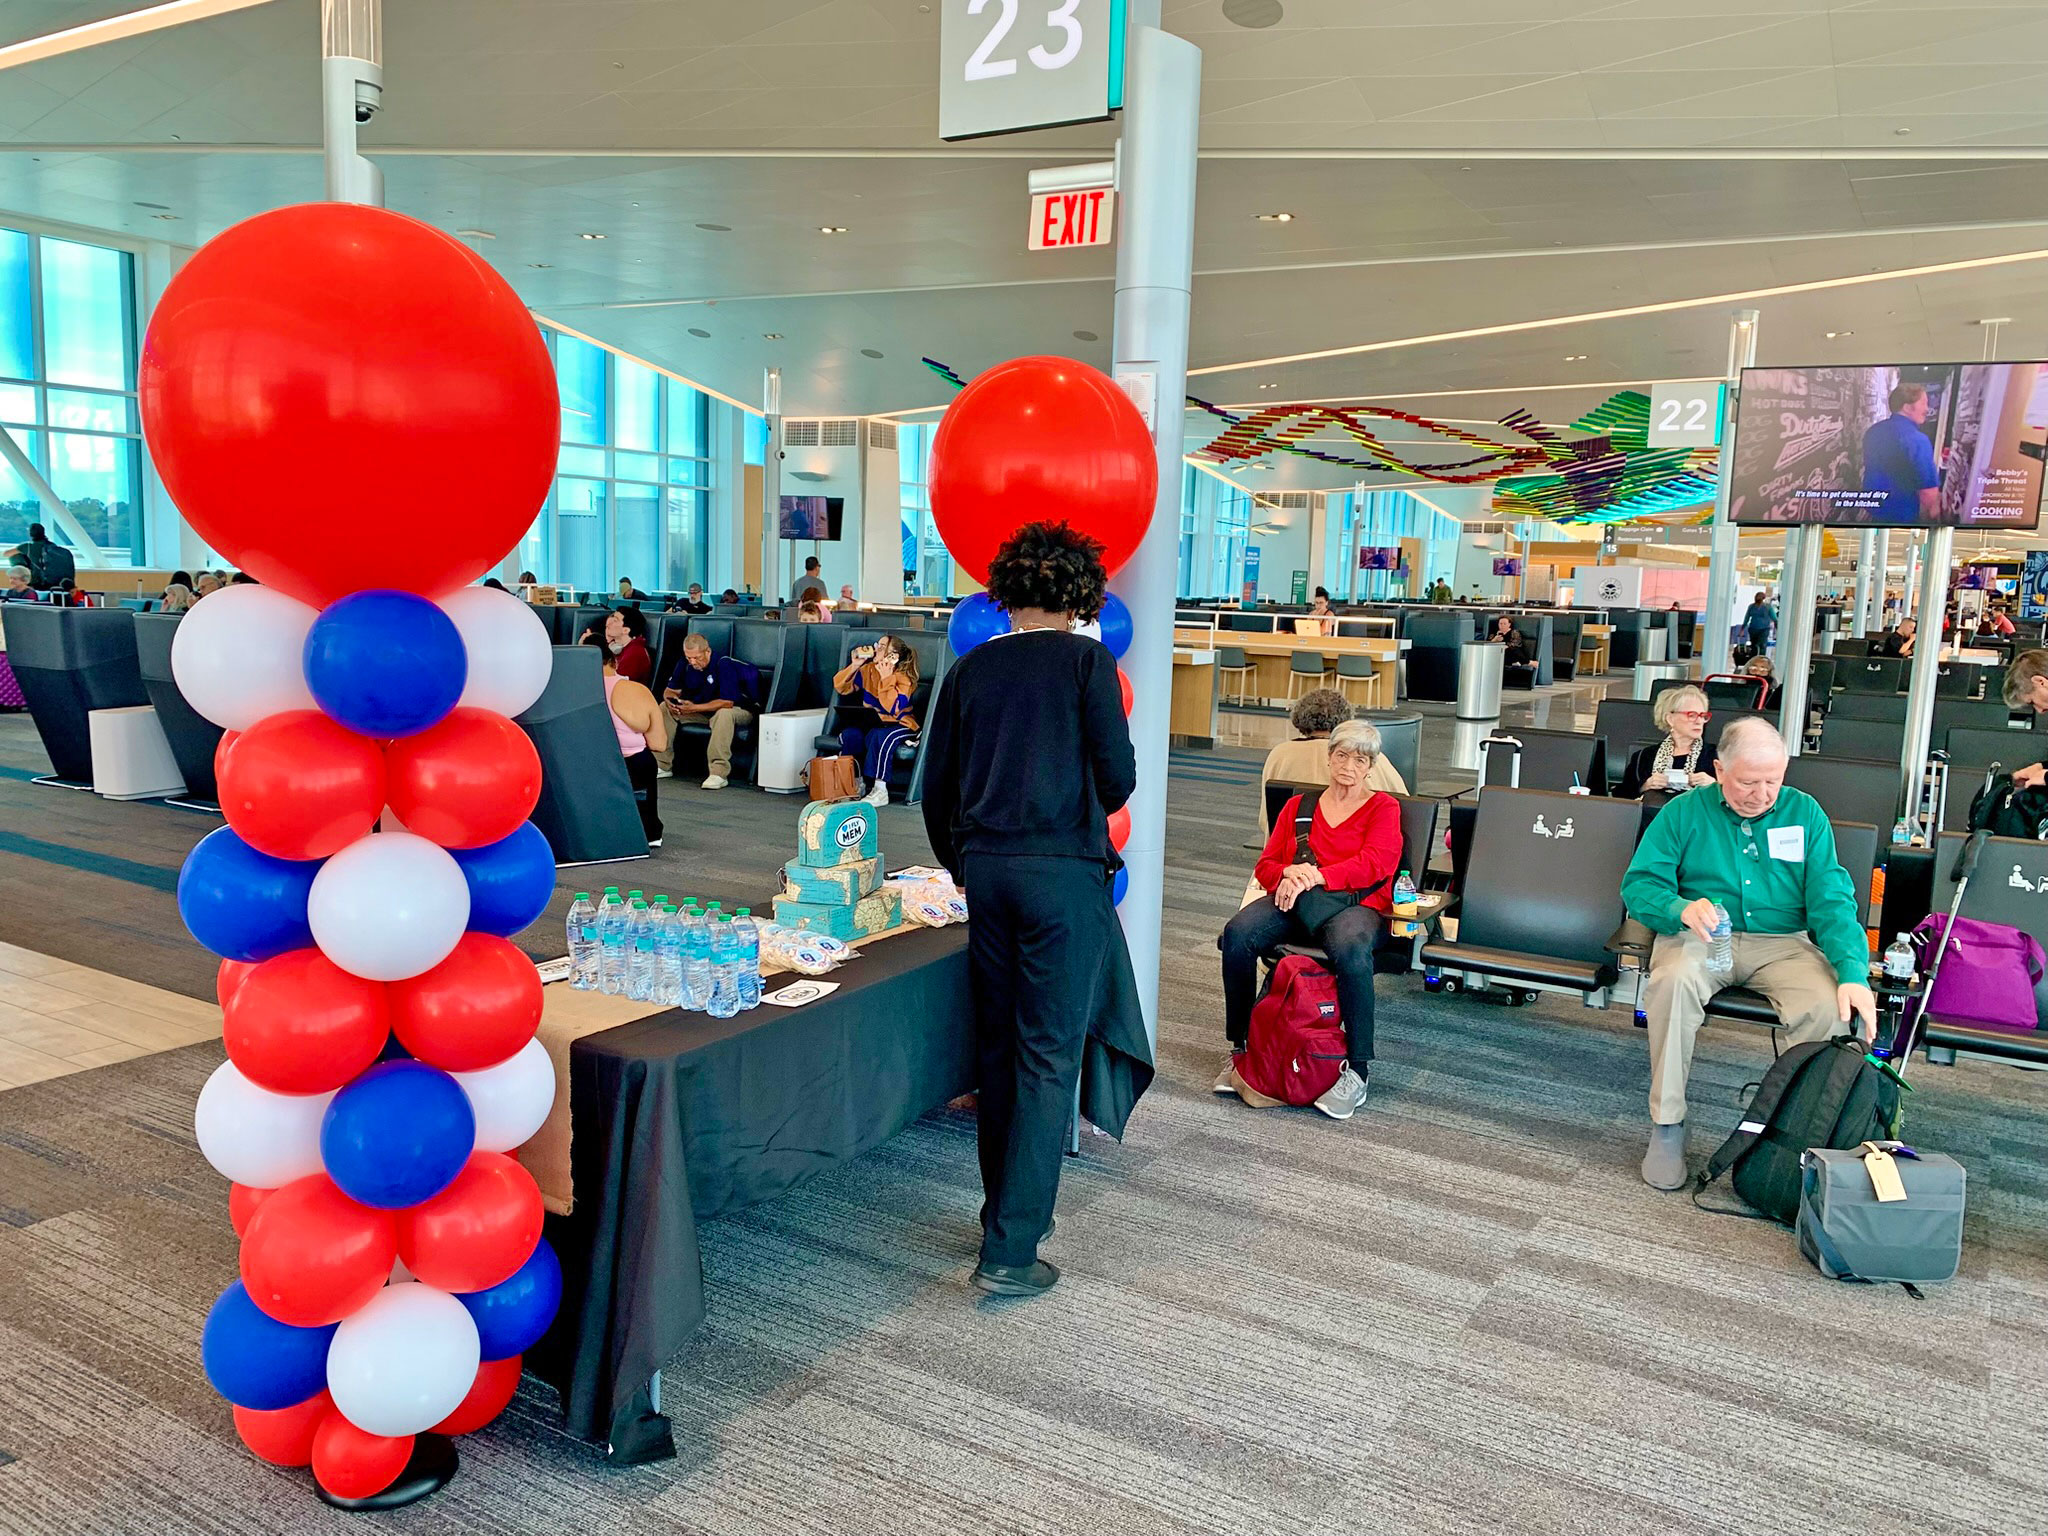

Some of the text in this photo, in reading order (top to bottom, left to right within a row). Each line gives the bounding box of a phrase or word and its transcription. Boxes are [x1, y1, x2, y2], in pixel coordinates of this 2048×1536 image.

[964, 0, 1083, 82] 23
[1042, 191, 1105, 247] EXIT
[1658, 399, 1707, 432] 22
[1996, 469, 2028, 477] Bobby's
[1795, 490, 1806, 498] It's
[1806, 490, 1821, 498] time
[1821, 490, 1829, 498] to
[1829, 491, 1841, 499] get
[1872, 491, 1889, 500] dirty
[1854, 500, 1880, 508] kitchen.
[1971, 506, 2024, 516] COOKING
[1606, 544, 1617, 553] 15
[842, 826, 862, 843] MEM
